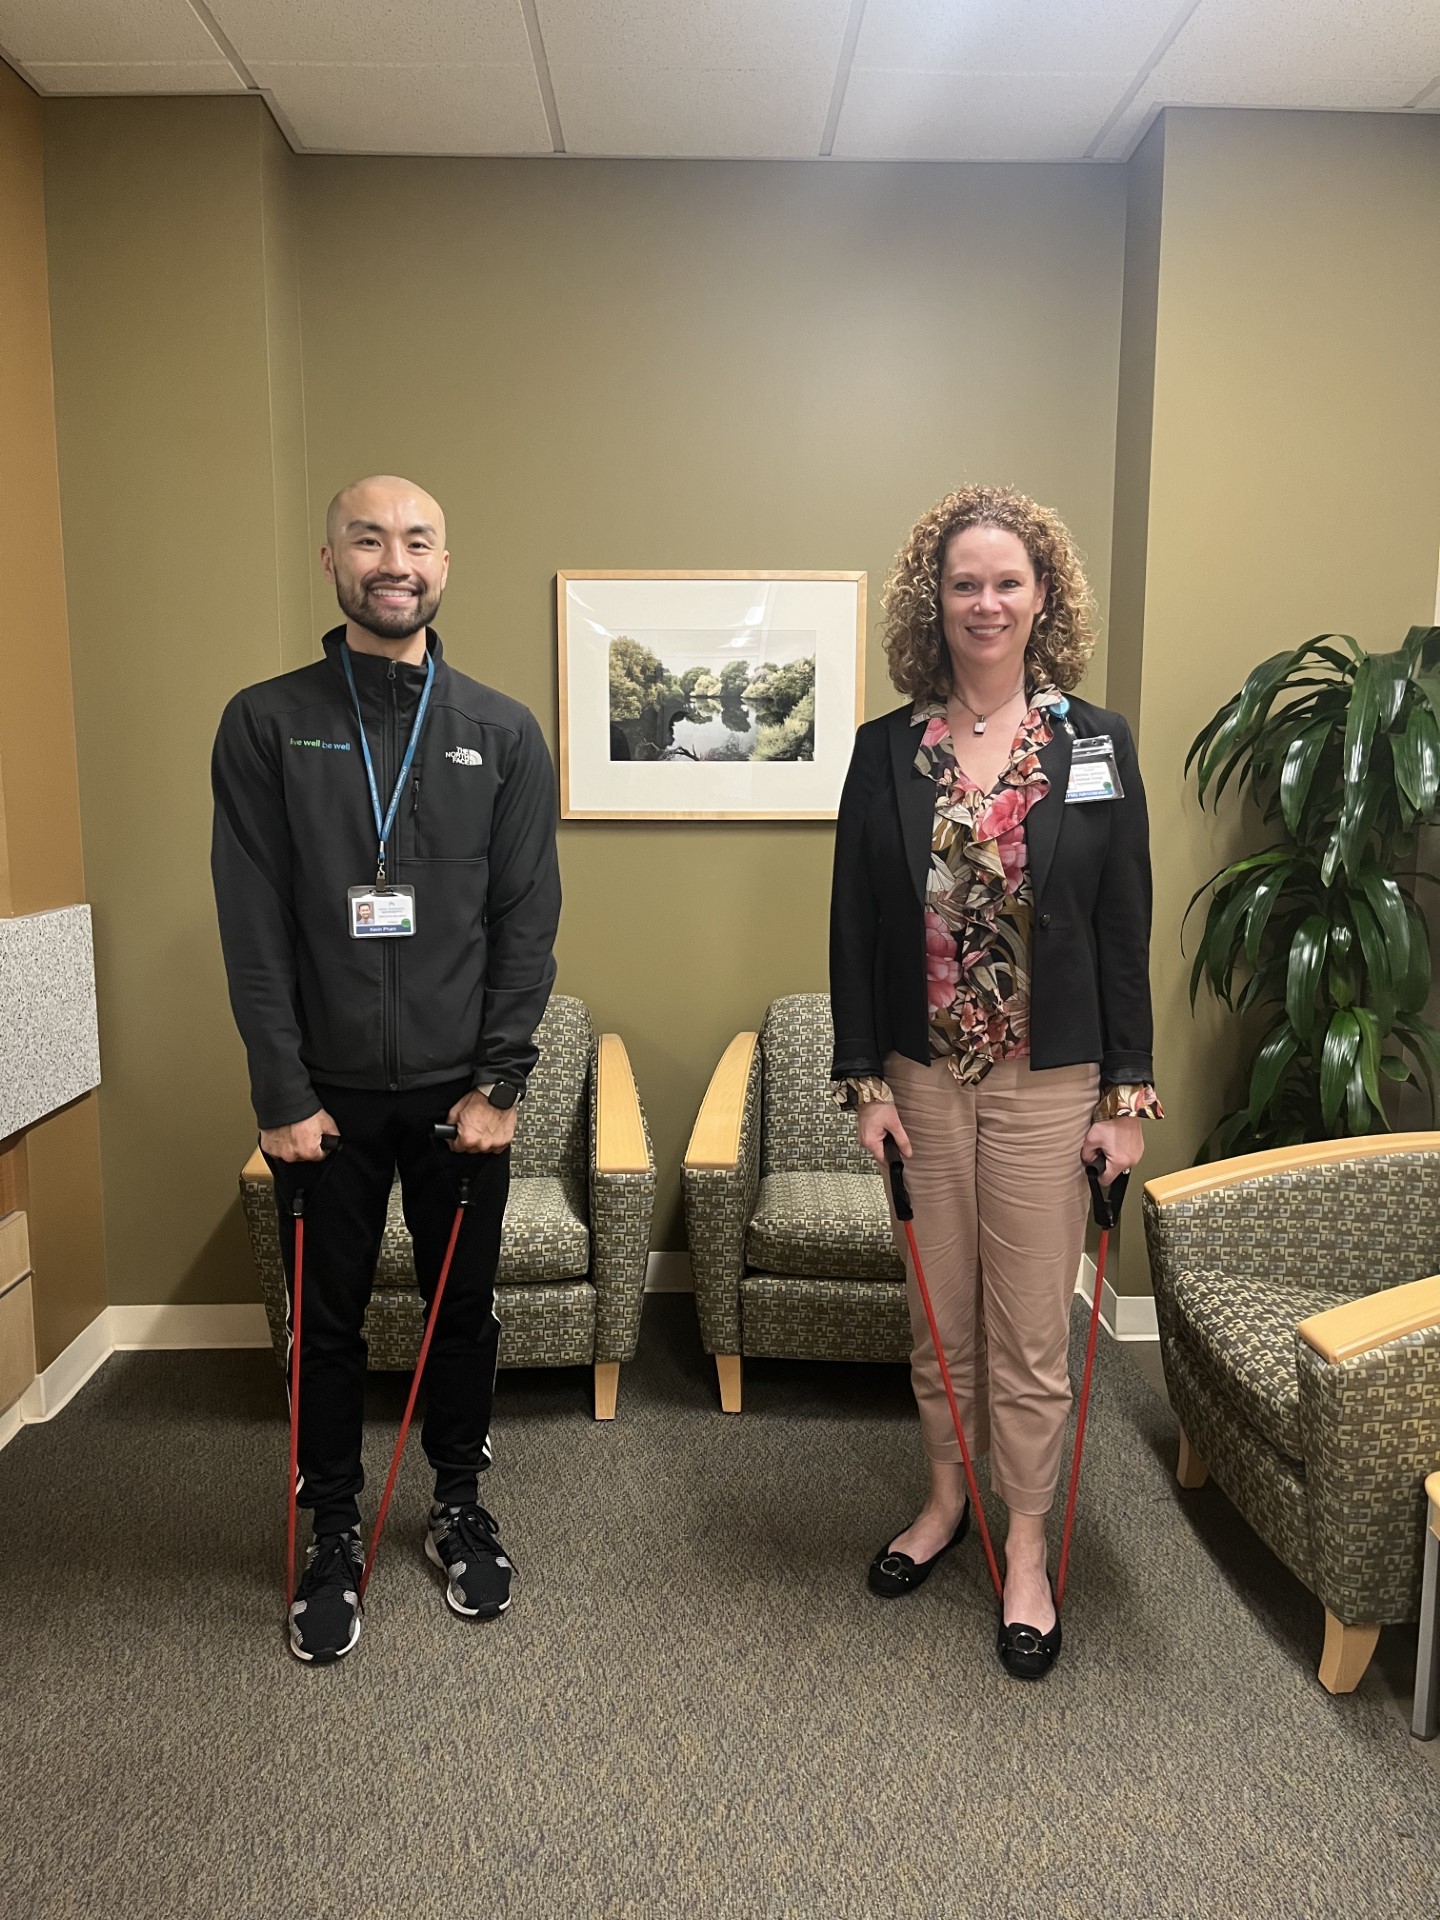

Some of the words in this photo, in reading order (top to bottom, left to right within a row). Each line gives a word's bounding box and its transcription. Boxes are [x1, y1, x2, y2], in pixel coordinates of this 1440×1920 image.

[303, 739, 321, 747] well
[322, 741, 333, 749] be
[333, 742, 351, 751] well
[456, 745, 469, 753] THE
[445, 751, 470, 760] NORTH
[452, 757, 470, 765] FACE
